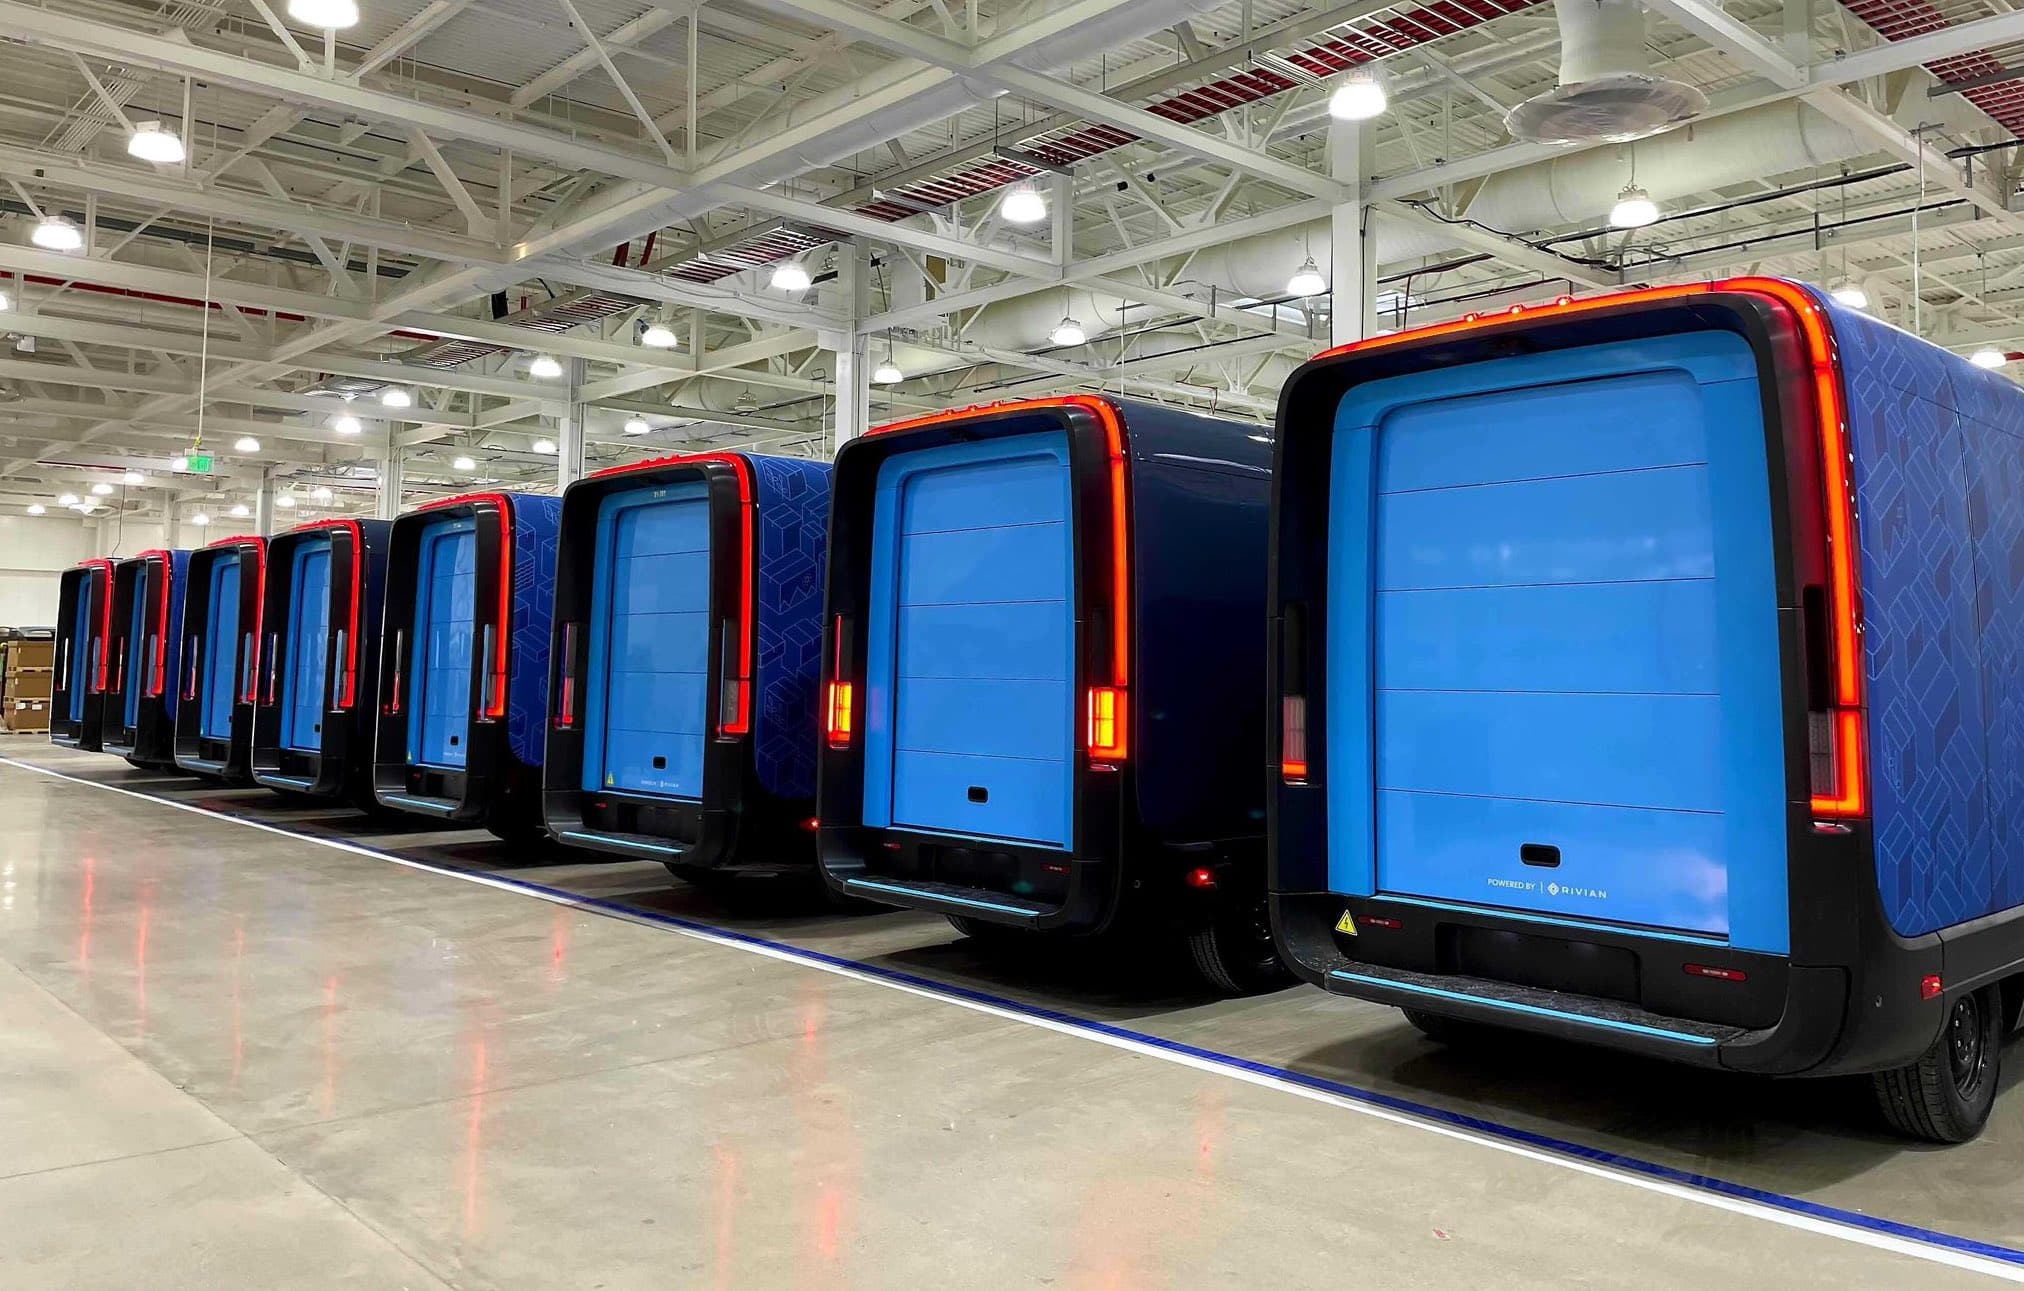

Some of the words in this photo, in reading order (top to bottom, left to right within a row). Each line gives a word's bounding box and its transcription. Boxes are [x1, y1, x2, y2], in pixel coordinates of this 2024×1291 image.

[1487, 878, 1525, 889] POWERED
[1525, 881, 1536, 890] BY
[1561, 886, 1607, 899] RIVIAN
